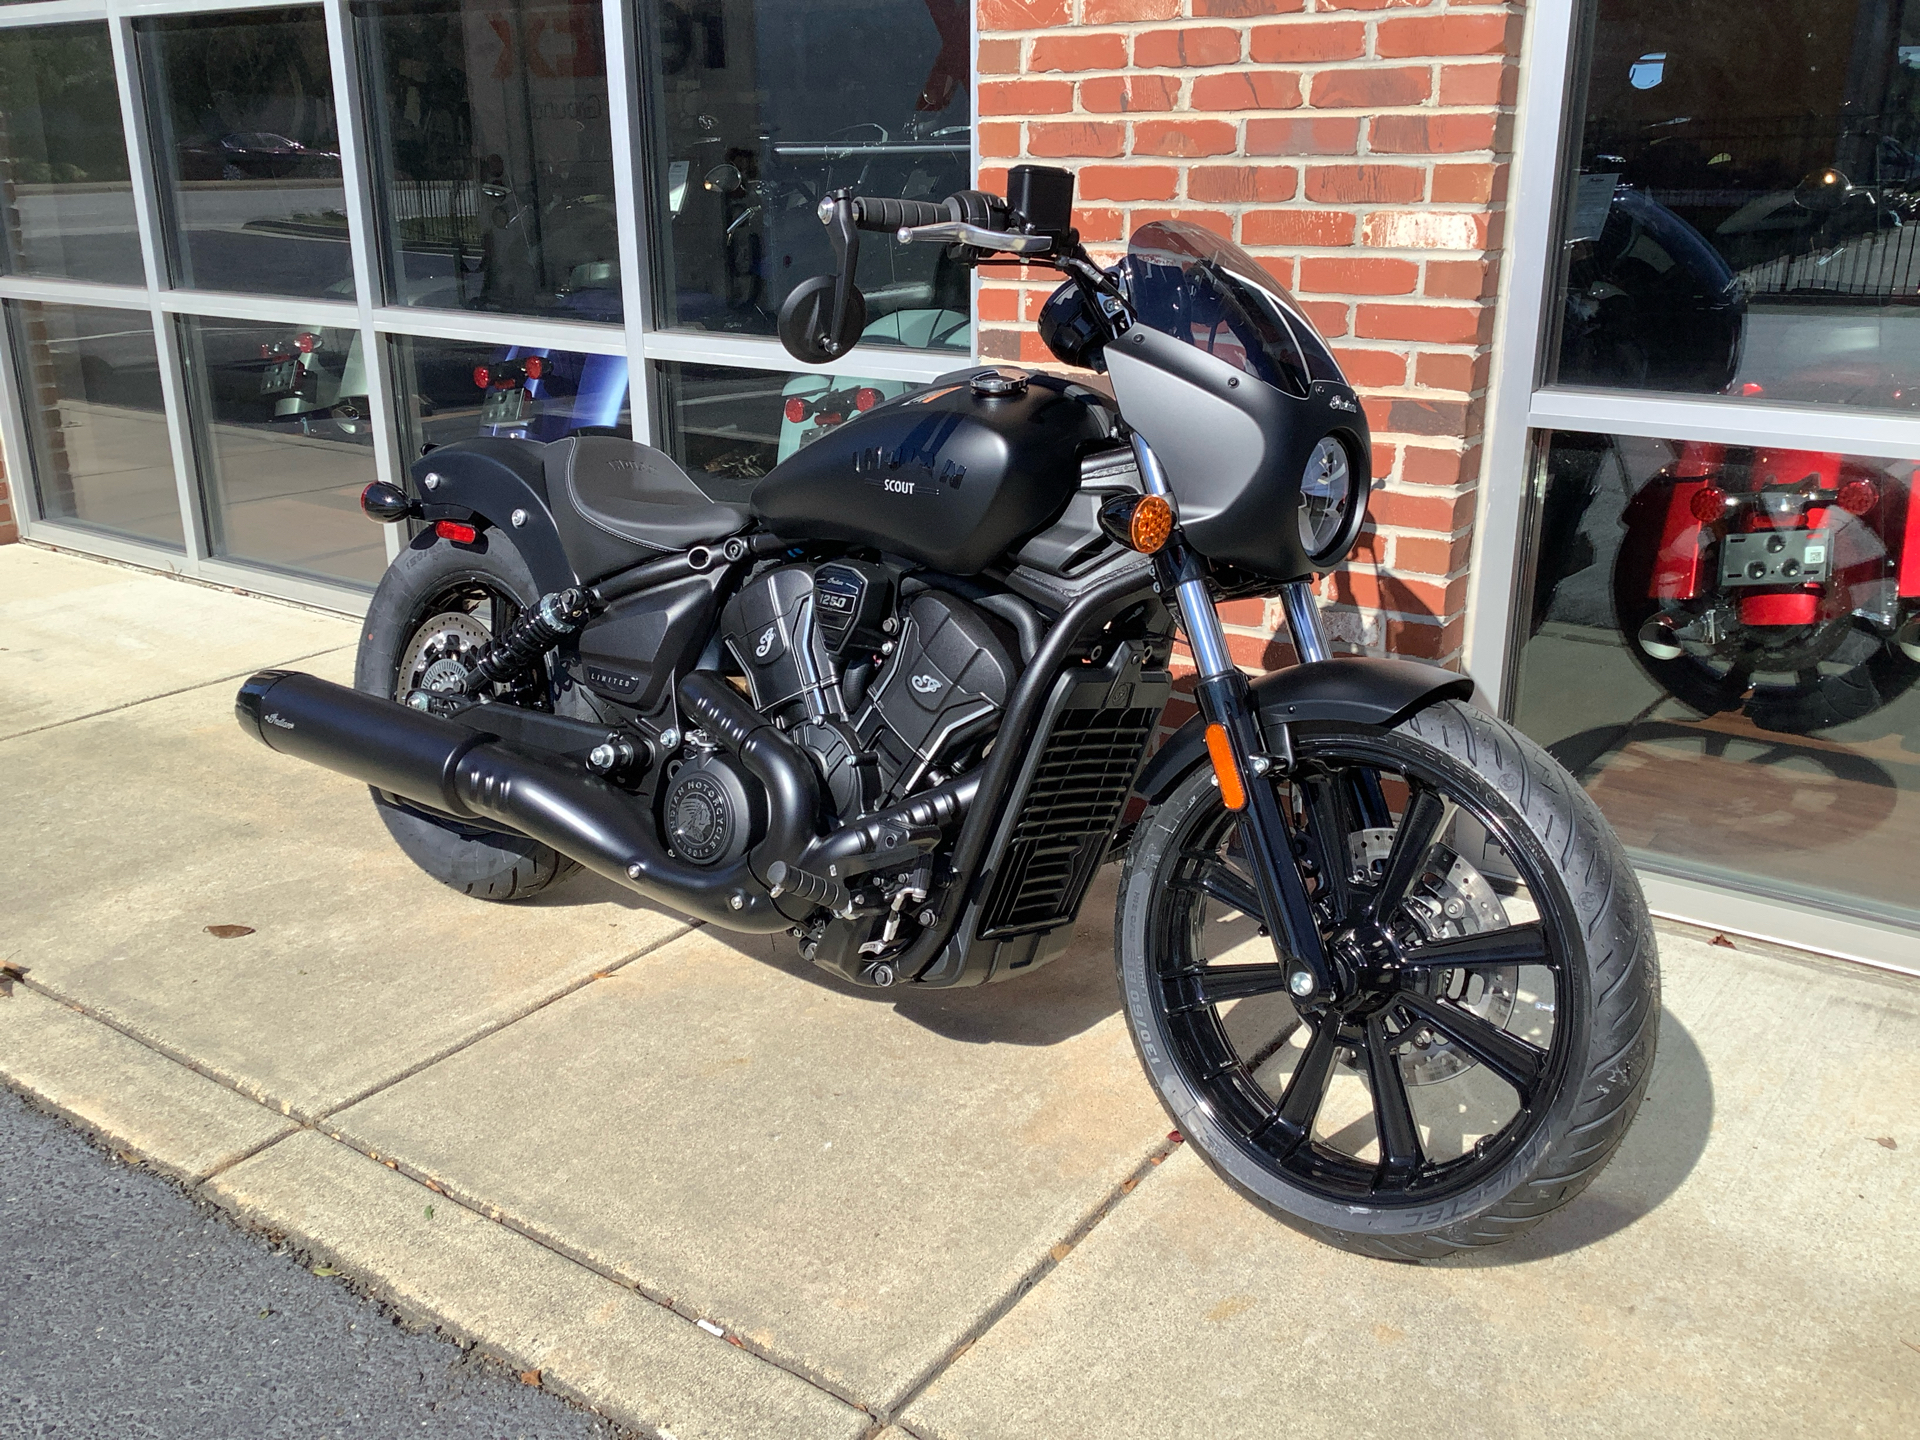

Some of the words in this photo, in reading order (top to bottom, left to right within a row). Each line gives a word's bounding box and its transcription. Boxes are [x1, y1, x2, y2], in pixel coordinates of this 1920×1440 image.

[884, 478, 915, 495] SCOUT
[819, 593, 847, 609] 1250
[590, 672, 630, 687] LIMITED
[1130, 989, 1161, 1066] 130/60
